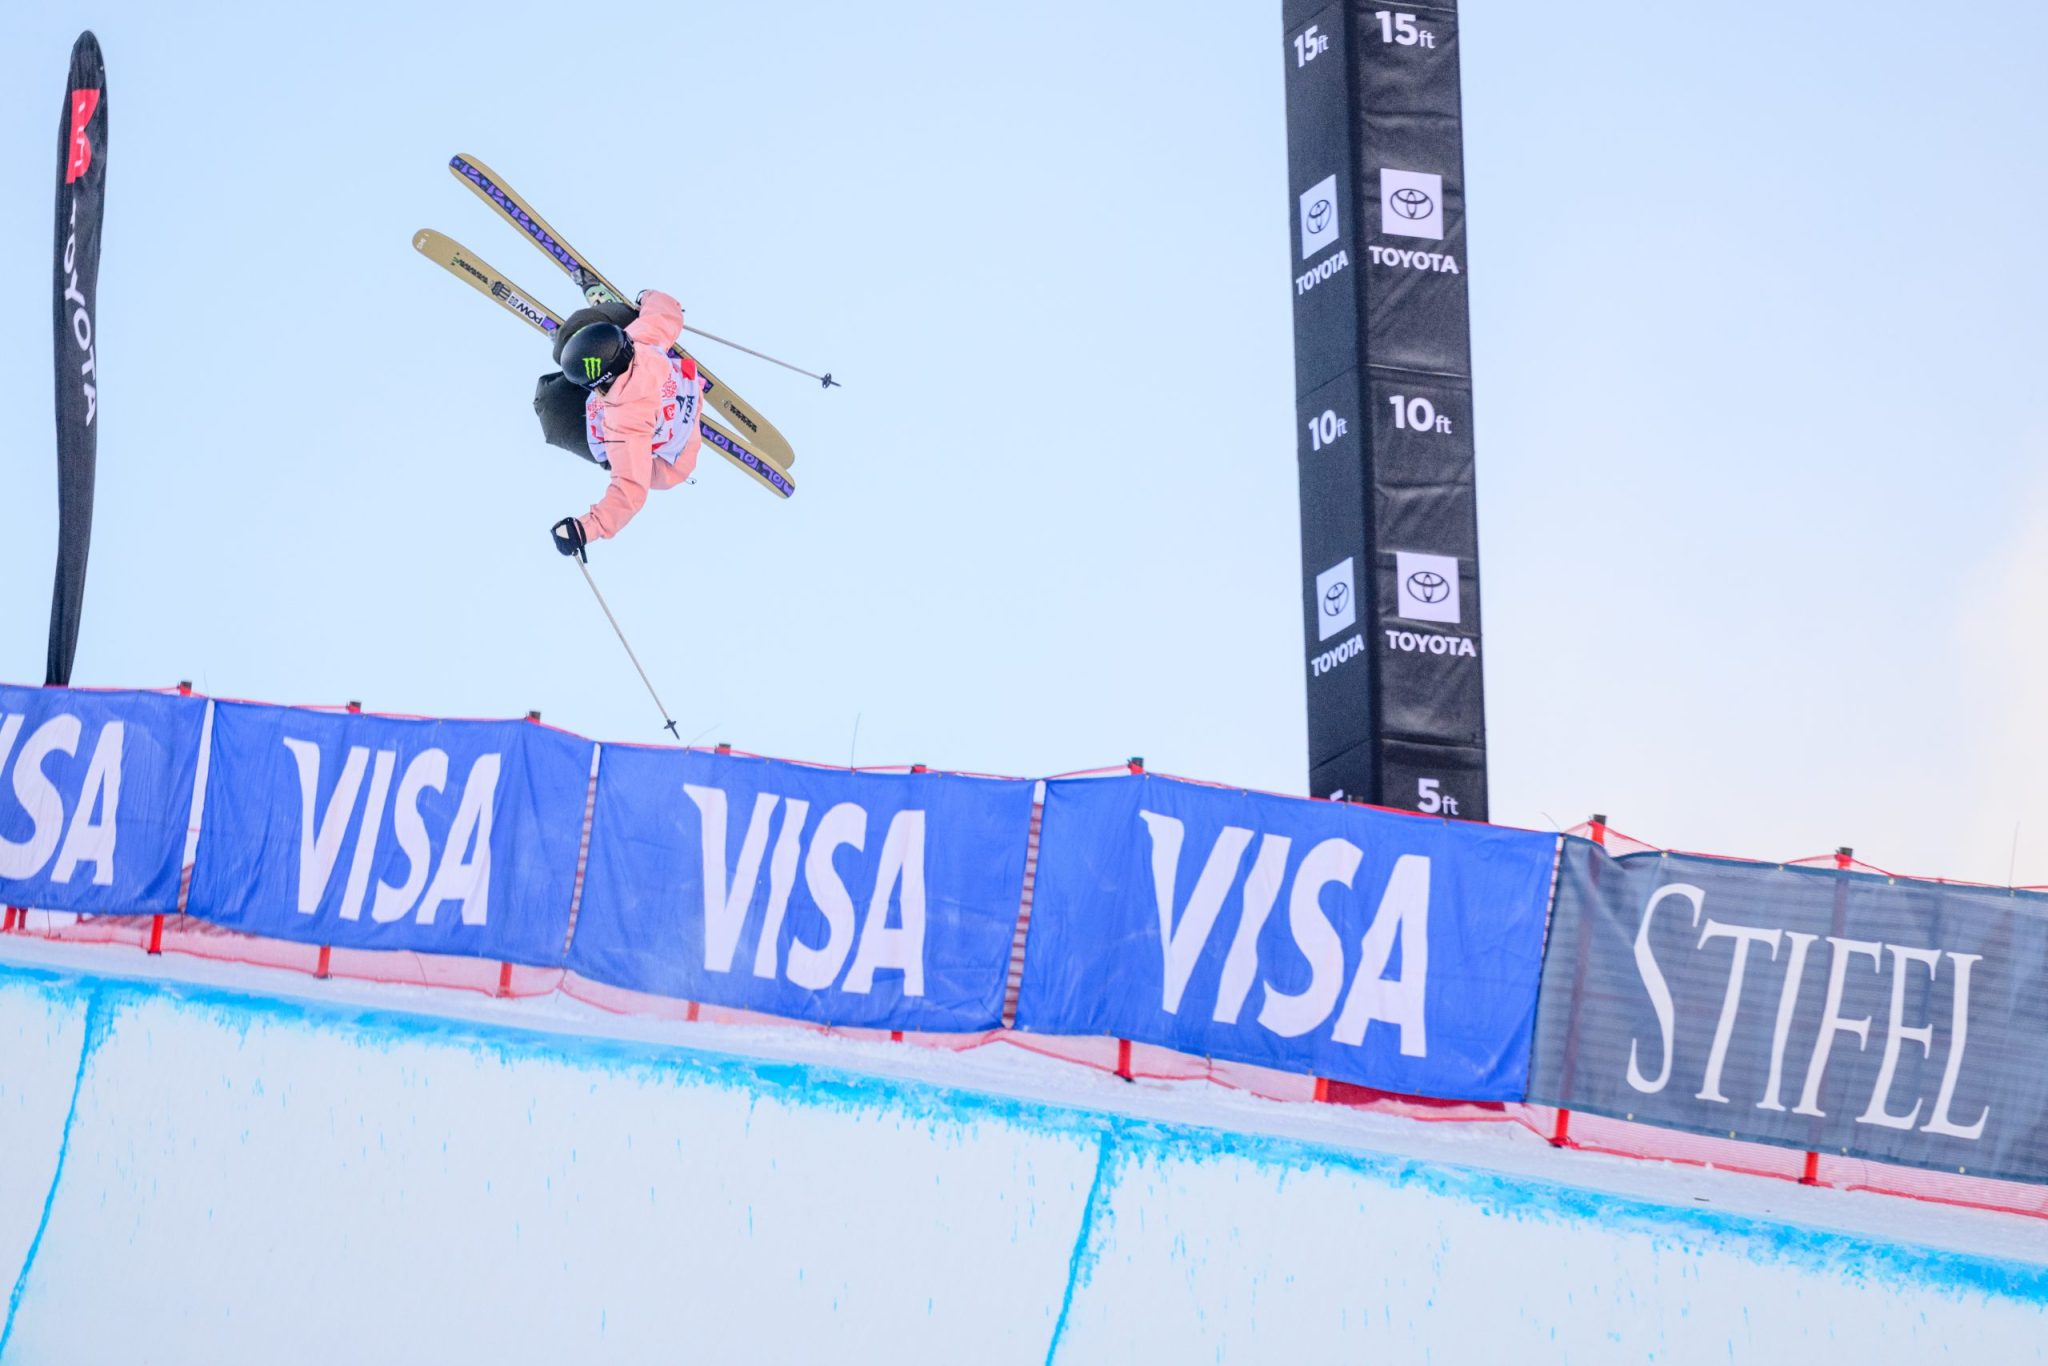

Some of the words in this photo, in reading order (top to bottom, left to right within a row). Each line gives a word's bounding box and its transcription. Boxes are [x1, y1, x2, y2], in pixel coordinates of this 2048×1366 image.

[1293, 24, 1330, 68] 15ft
[1375, 10, 1436, 49] 15ft
[1295, 250, 1349, 296] TOYOTA
[1369, 245, 1460, 275] TOYOTA
[516, 302, 544, 325] POW
[1308, 409, 1348, 451] 10ft
[1389, 394, 1452, 435] 10ft
[1311, 634, 1365, 677] TOYOTA
[1386, 630, 1477, 658] TOYOTA
[0, 713, 125, 886] SA
[1417, 777, 1460, 816] 5ft
[283, 737, 502, 926] VISA
[682, 783, 926, 998] VISA
[1139, 809, 1431, 1058] VISA
[1627, 883, 1989, 1139] STIFEL
